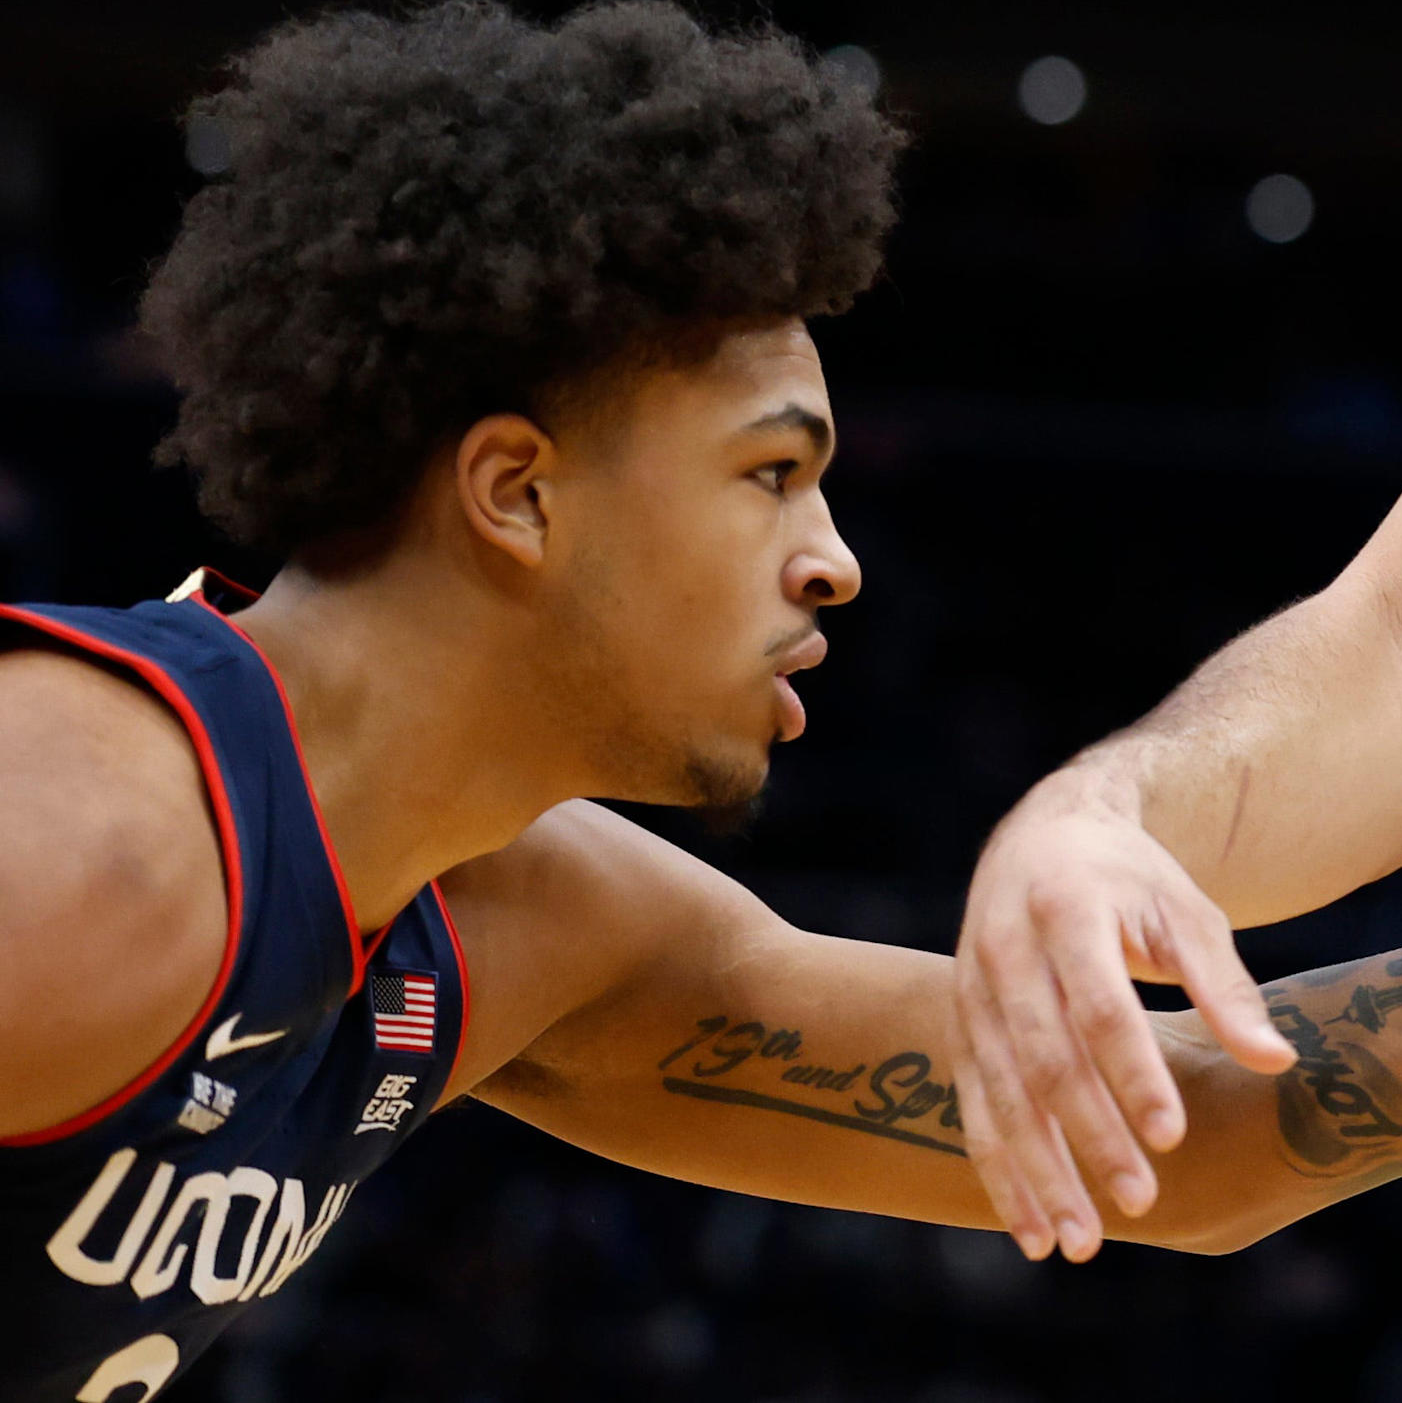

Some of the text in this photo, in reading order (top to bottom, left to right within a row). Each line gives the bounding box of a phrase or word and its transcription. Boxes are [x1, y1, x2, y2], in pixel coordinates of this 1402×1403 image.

[658, 1015, 803, 1077] 19th
[782, 1063, 866, 1092] and
[374, 1073, 418, 1098] BIG
[362, 1097, 415, 1123] EAST
